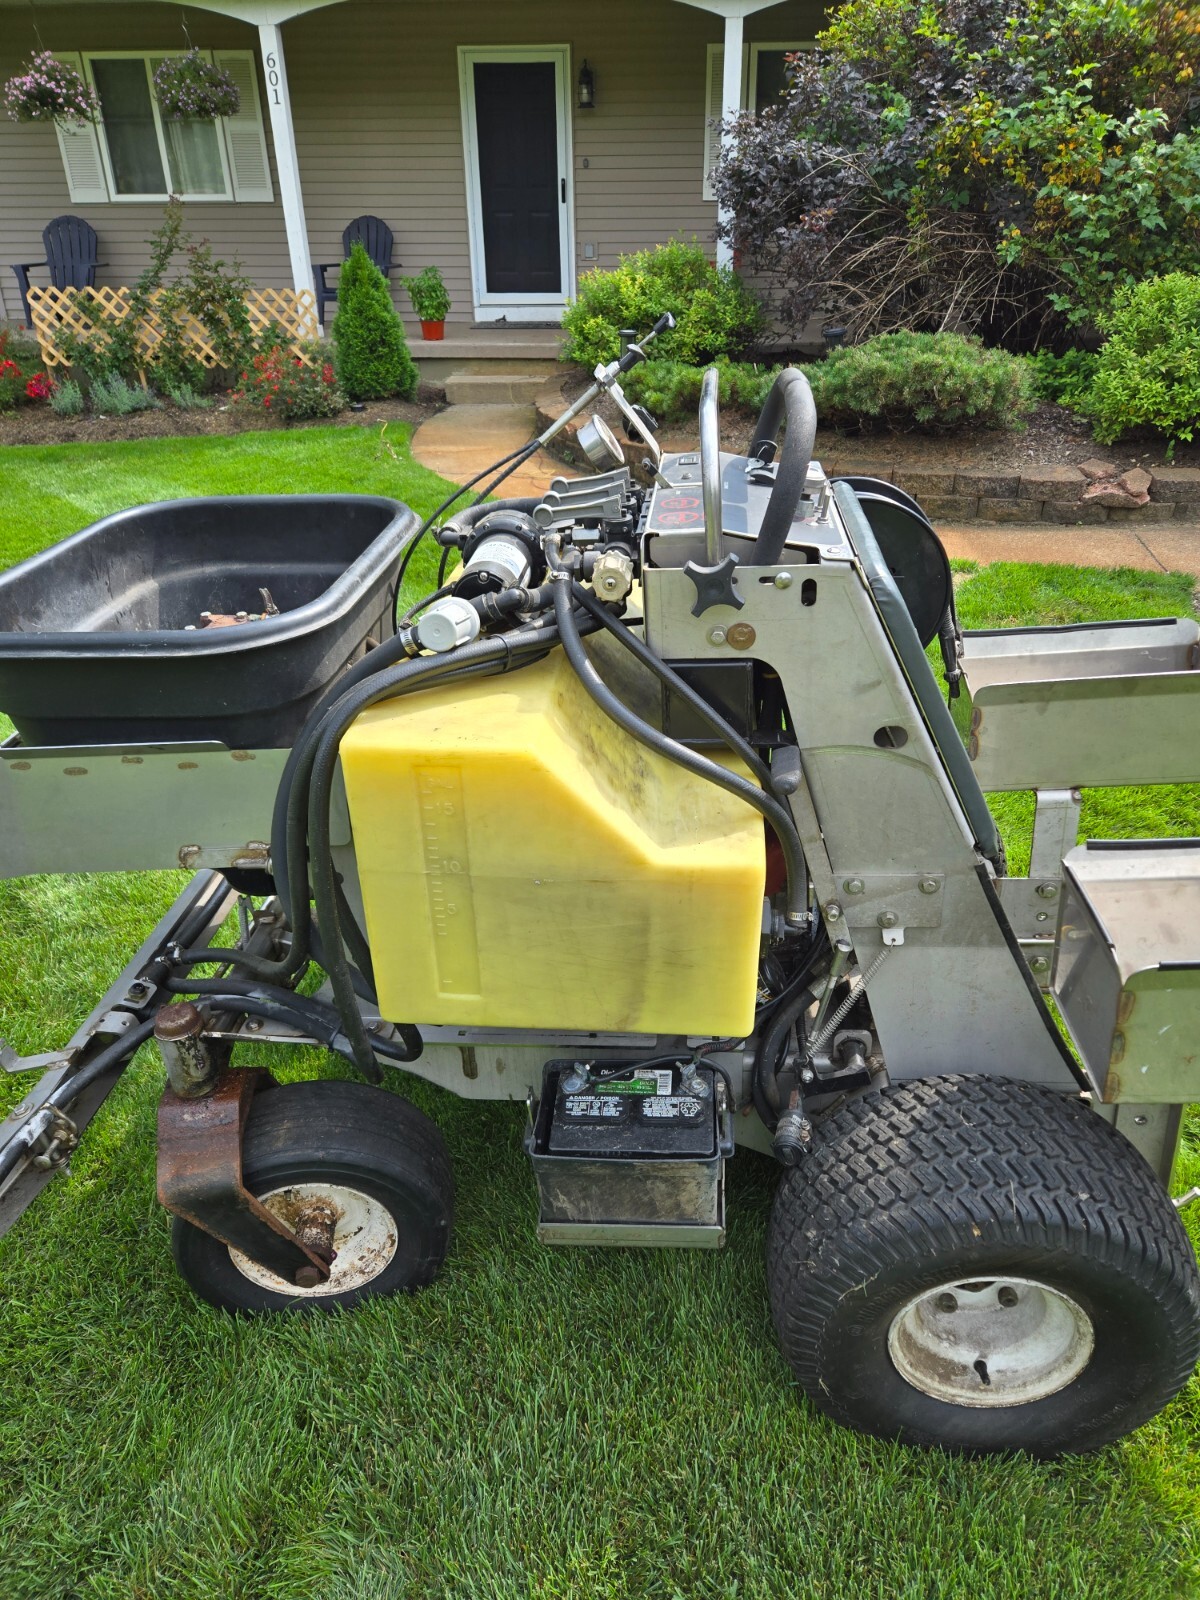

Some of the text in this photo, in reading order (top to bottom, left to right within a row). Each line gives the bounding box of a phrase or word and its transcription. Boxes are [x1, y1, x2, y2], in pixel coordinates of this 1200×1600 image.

[266, 52, 281, 104] 601
[443, 861, 461, 872] 10
[447, 903, 457, 915] 5
